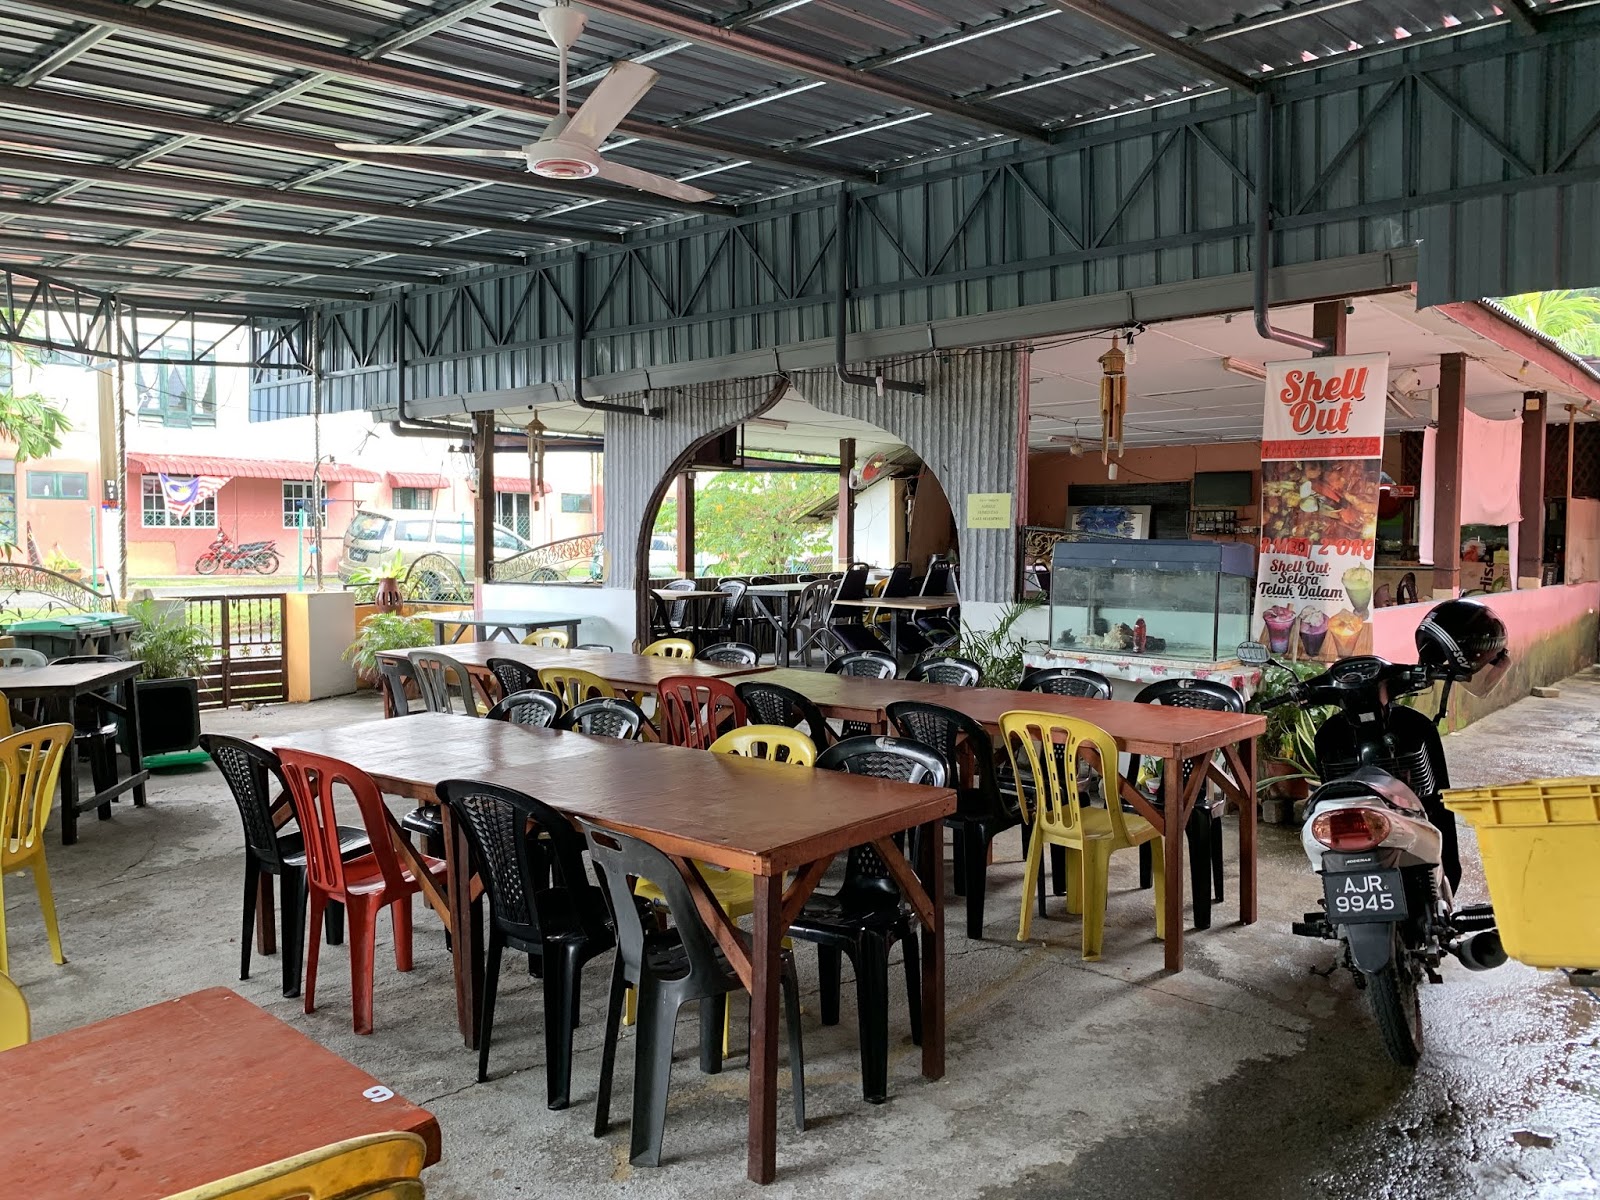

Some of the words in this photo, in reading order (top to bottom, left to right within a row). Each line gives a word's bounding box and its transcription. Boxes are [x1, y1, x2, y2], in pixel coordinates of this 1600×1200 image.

[1279, 366, 1368, 405] Shell
[1289, 399, 1353, 435] Out
[1318, 538, 1331, 555] 2
[1336, 538, 1375, 560] ORG
[1270, 559, 1303, 573] Shell
[1305, 560, 1330, 573] Out
[1278, 571, 1319, 585] Selera
[1259, 582, 1293, 595] Teluk
[1297, 584, 1343, 598] Dalam
[1344, 875, 1383, 893] AJR
[1336, 893, 1395, 913] 9945
[362, 1085, 395, 1103] 9
